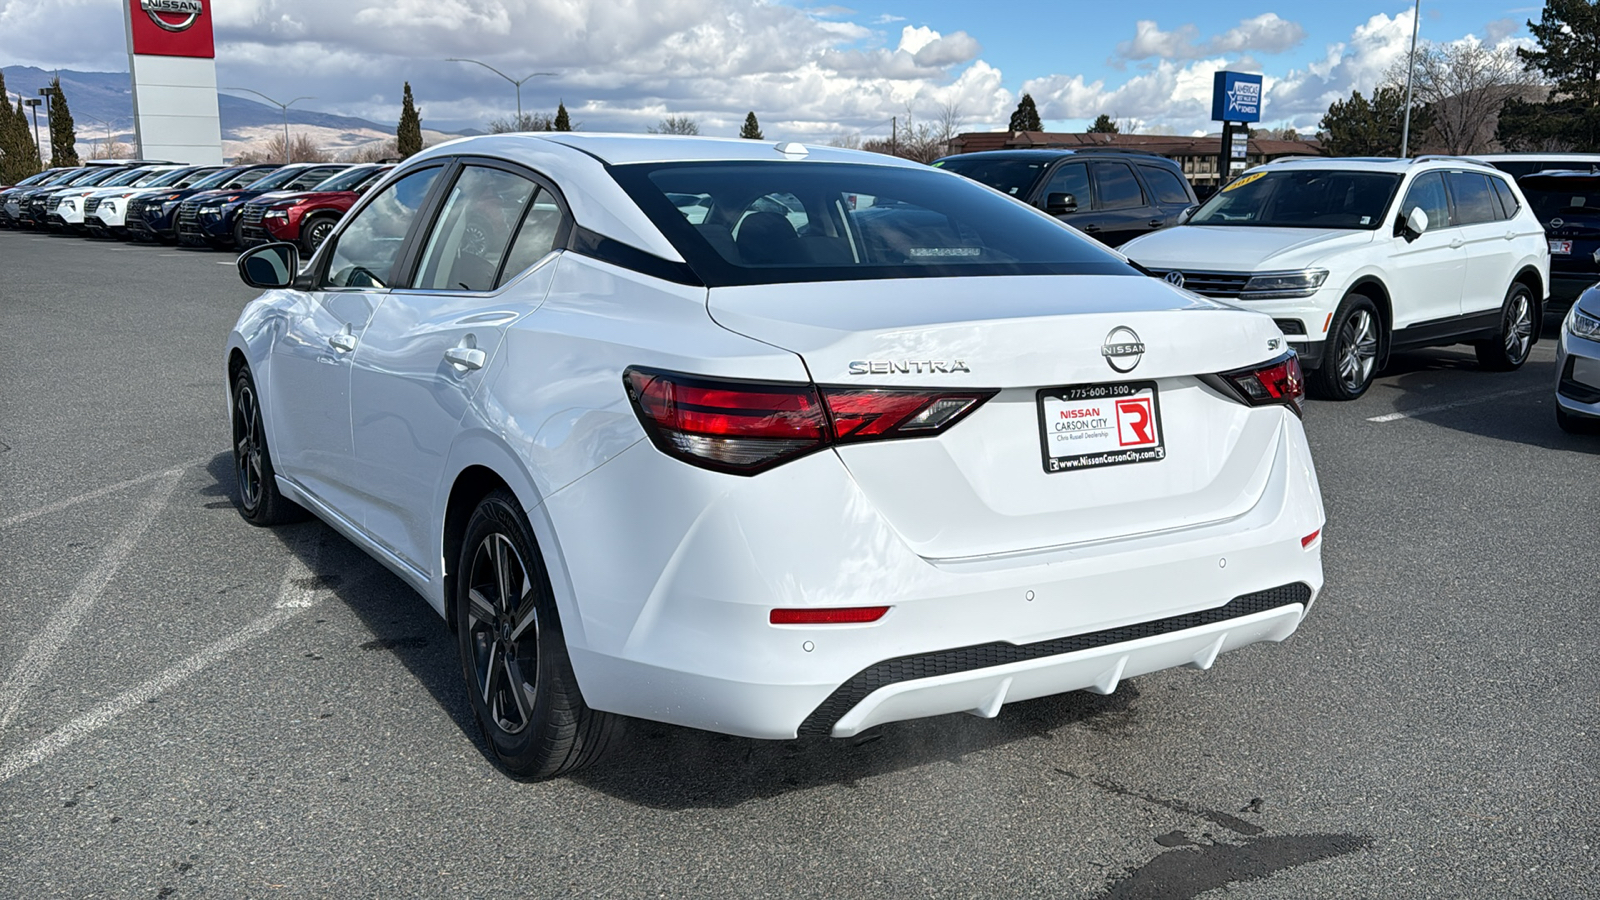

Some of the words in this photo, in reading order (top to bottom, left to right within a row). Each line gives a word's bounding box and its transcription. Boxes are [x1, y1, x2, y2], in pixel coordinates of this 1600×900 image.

[148, 0, 197, 10] NISSAN
[1103, 344, 1145, 354] NISSAN
[848, 359, 971, 375] SENTRA
[1070, 385, 1129, 398] 775-600-1500
[1060, 408, 1100, 419] NISSAN
[1054, 420, 1089, 432] CARSON
[1090, 418, 1108, 429] CITY
[1056, 434, 1069, 442] Chris
[1069, 433, 1084, 441] Russell
[1084, 431, 1109, 440] Dealership
[1059, 451, 1155, 468] www.NissanCarsonCity.com
